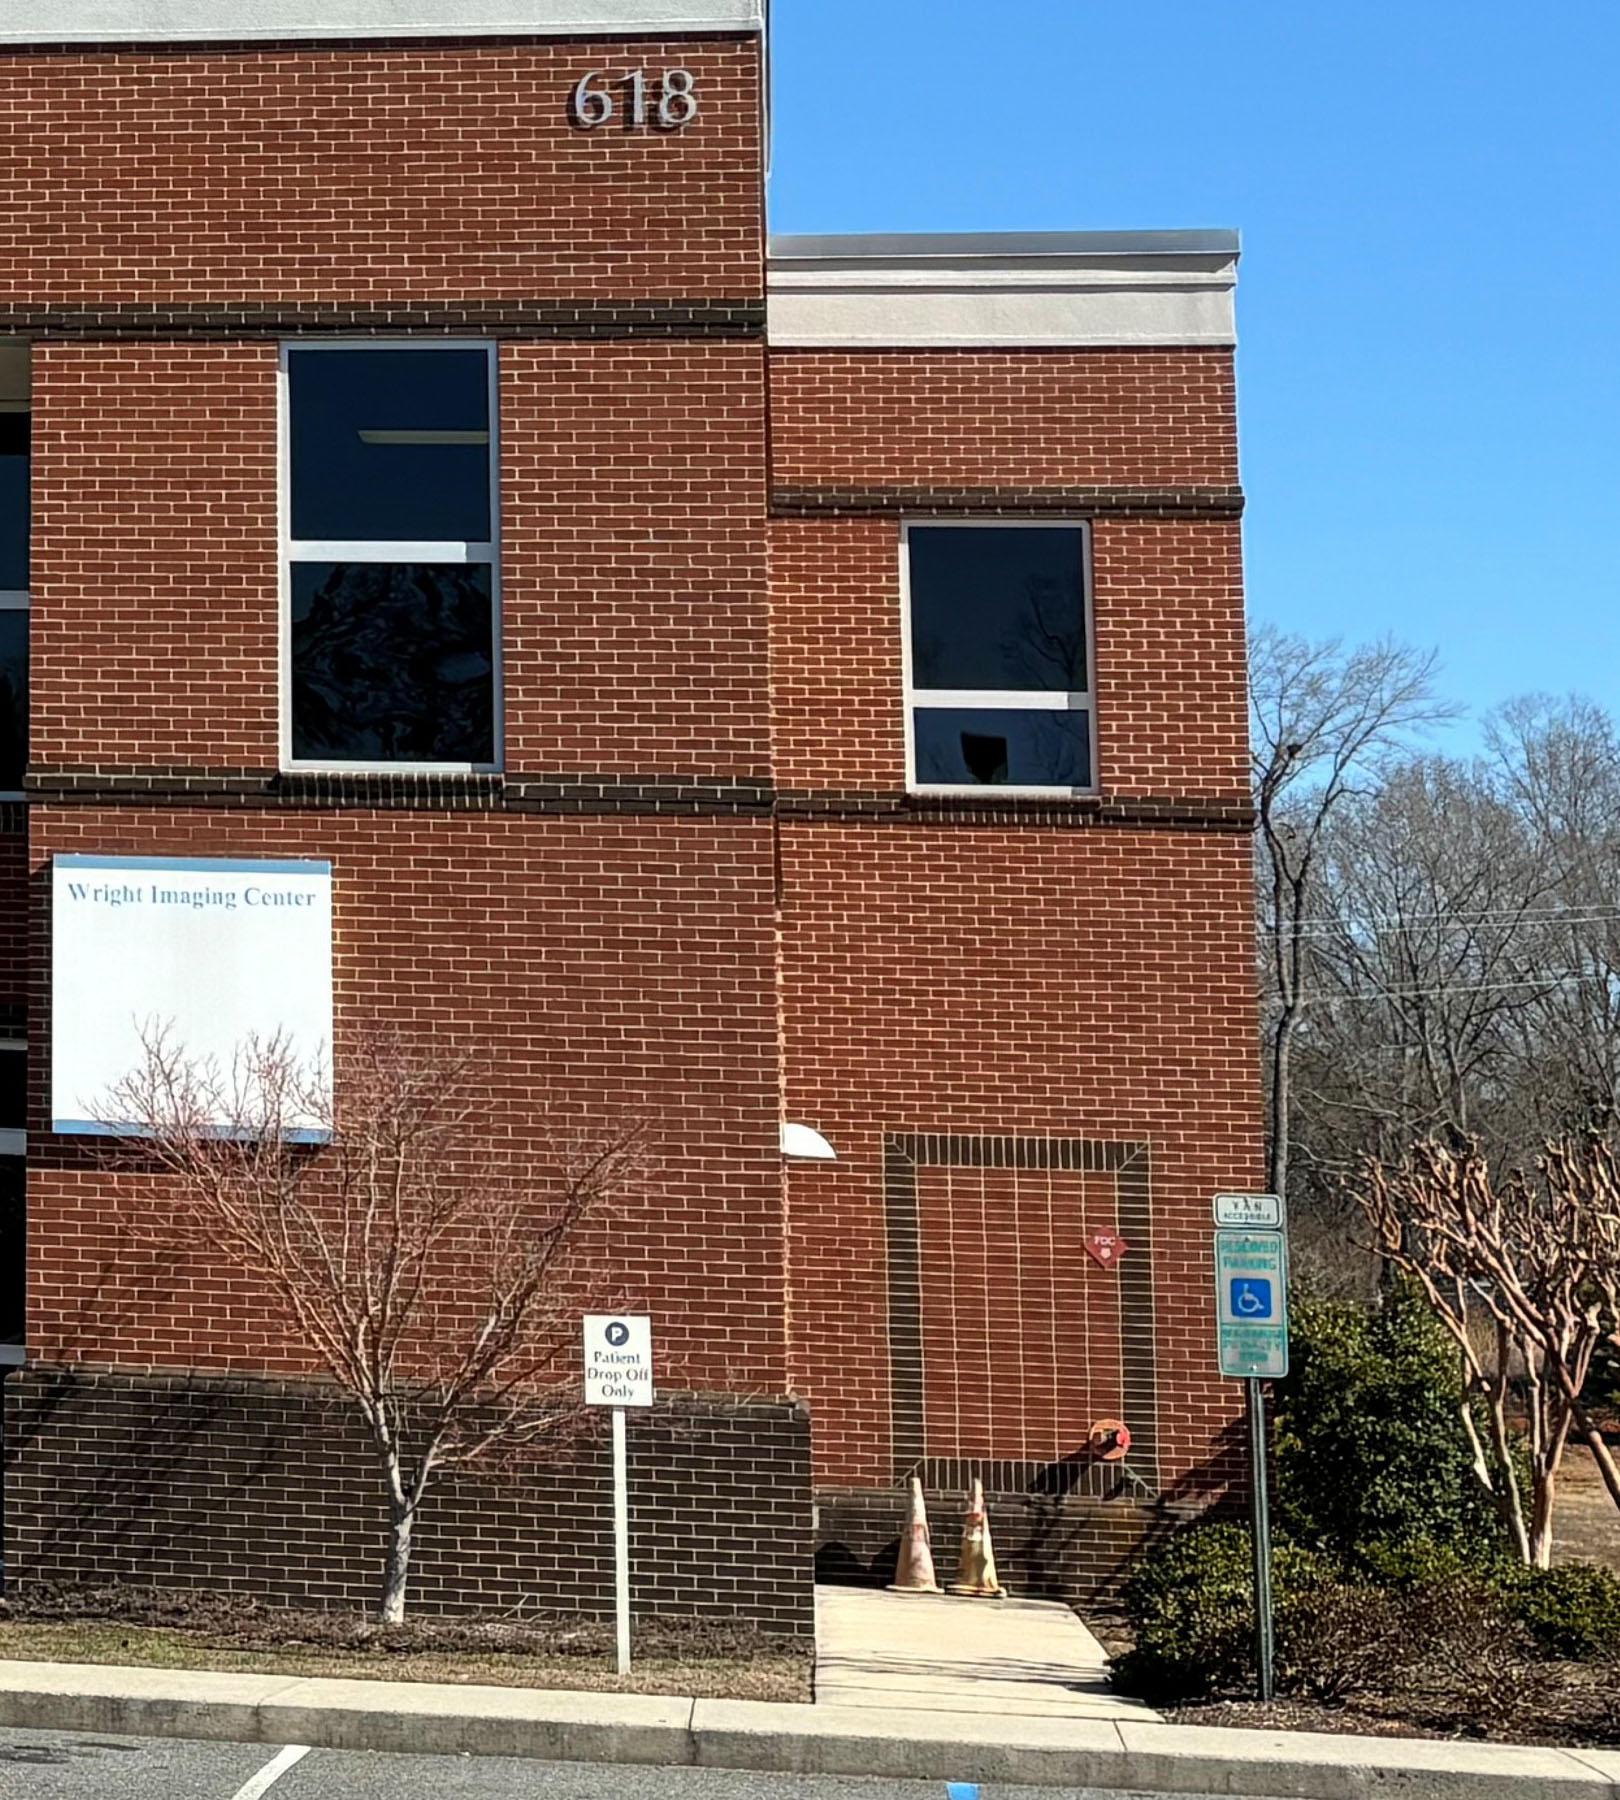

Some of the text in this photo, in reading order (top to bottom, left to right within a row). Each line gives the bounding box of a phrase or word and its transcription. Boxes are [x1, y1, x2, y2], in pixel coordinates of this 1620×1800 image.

[575, 67, 698, 126] 618
[67, 882, 317, 910] Wright Imaging Center
[1232, 1201, 1263, 1212] VAN
[1094, 1235, 1116, 1246] FDC
[594, 1351, 641, 1365] Patient
[587, 1367, 649, 1384] Drop Off
[601, 1384, 635, 1401] Only
